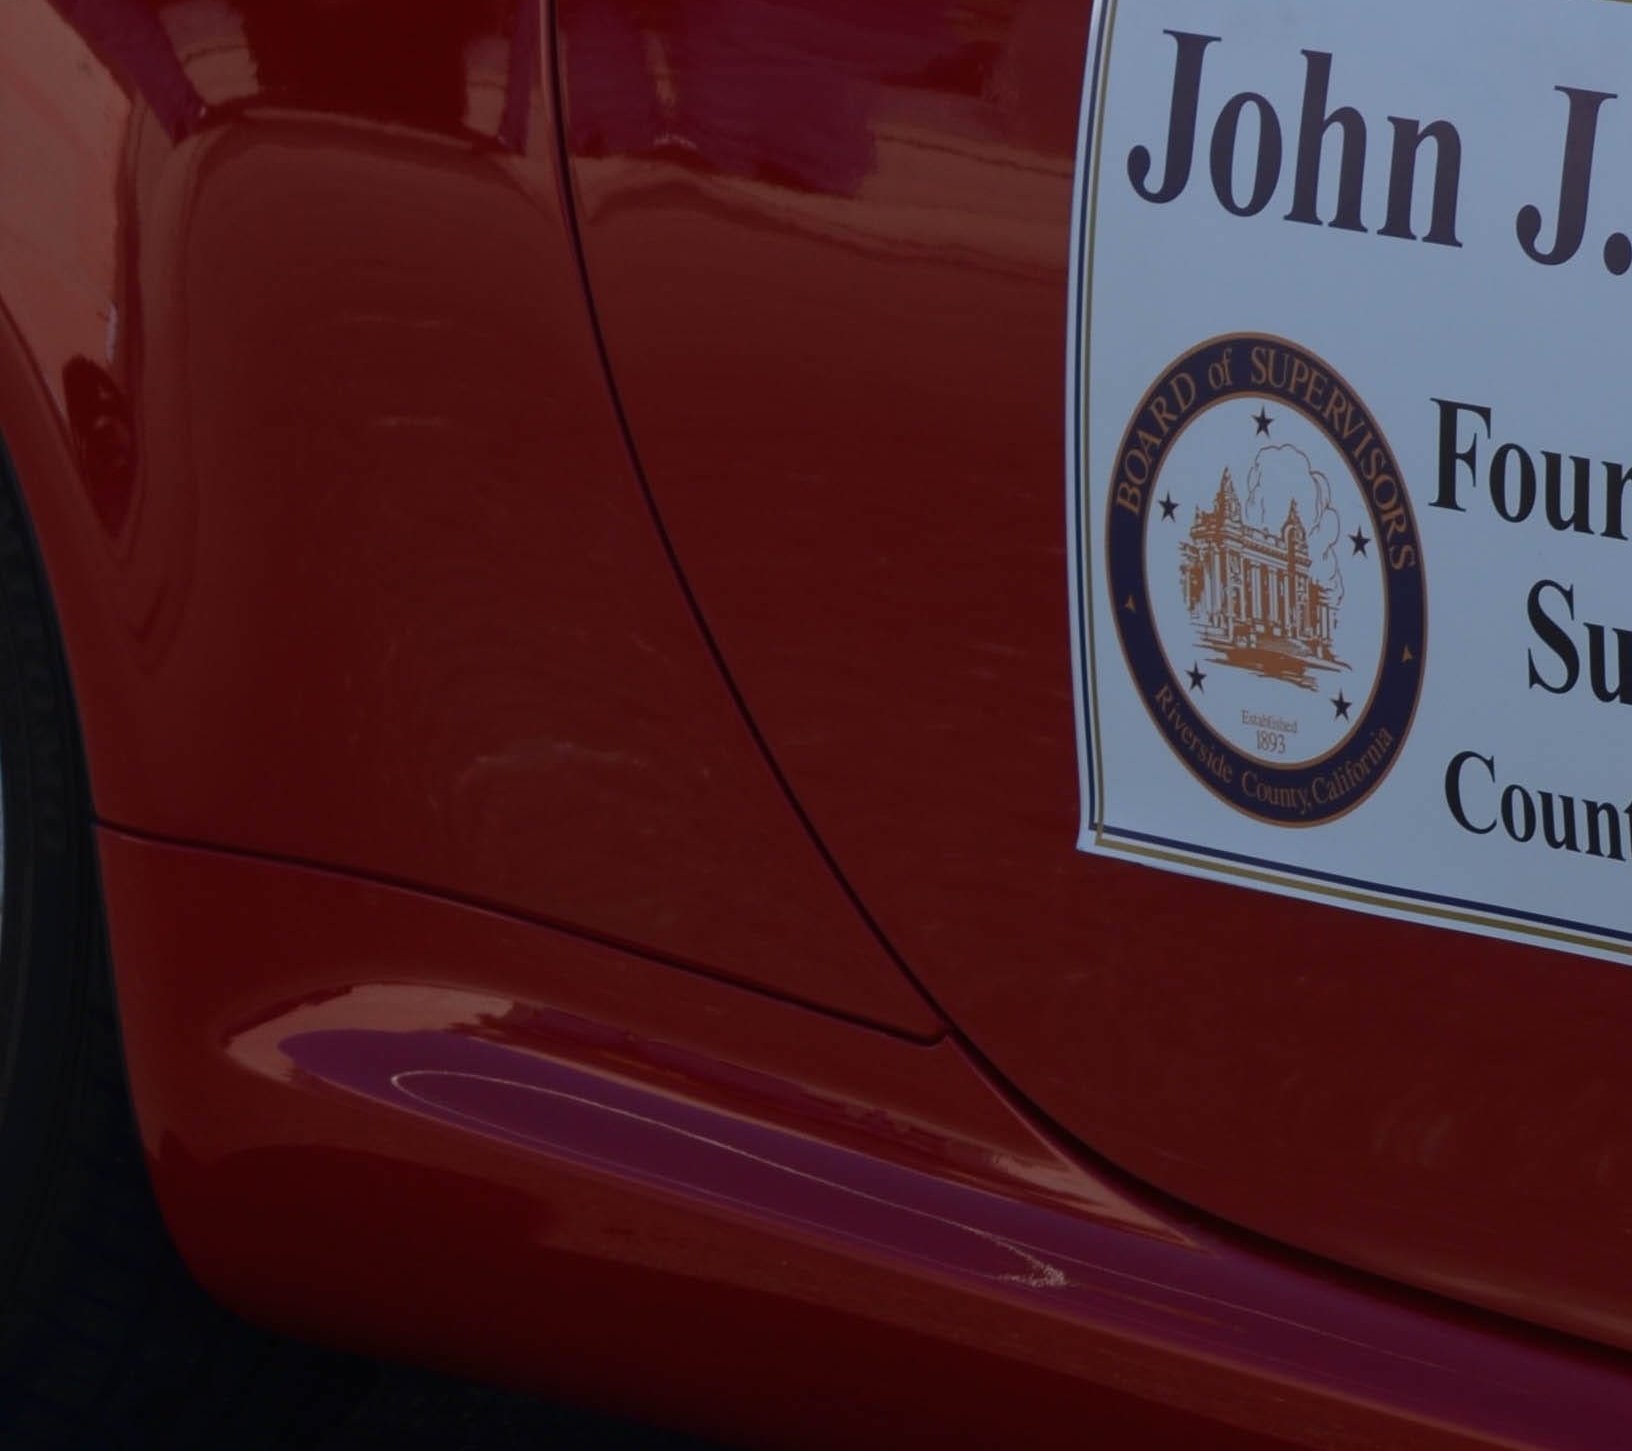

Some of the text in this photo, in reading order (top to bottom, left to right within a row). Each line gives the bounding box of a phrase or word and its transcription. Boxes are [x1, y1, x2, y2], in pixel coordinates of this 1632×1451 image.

[1126, 29, 1463, 248] John
[1515, 85, 1632, 276] J.
[1116, 346, 1416, 571] BOARD of SUPERVISORS
[1155, 683, 1233, 783] Riverside
[1312, 726, 1394, 803] California
[1241, 709, 1298, 734] Established
[1256, 730, 1286, 754] 1893
